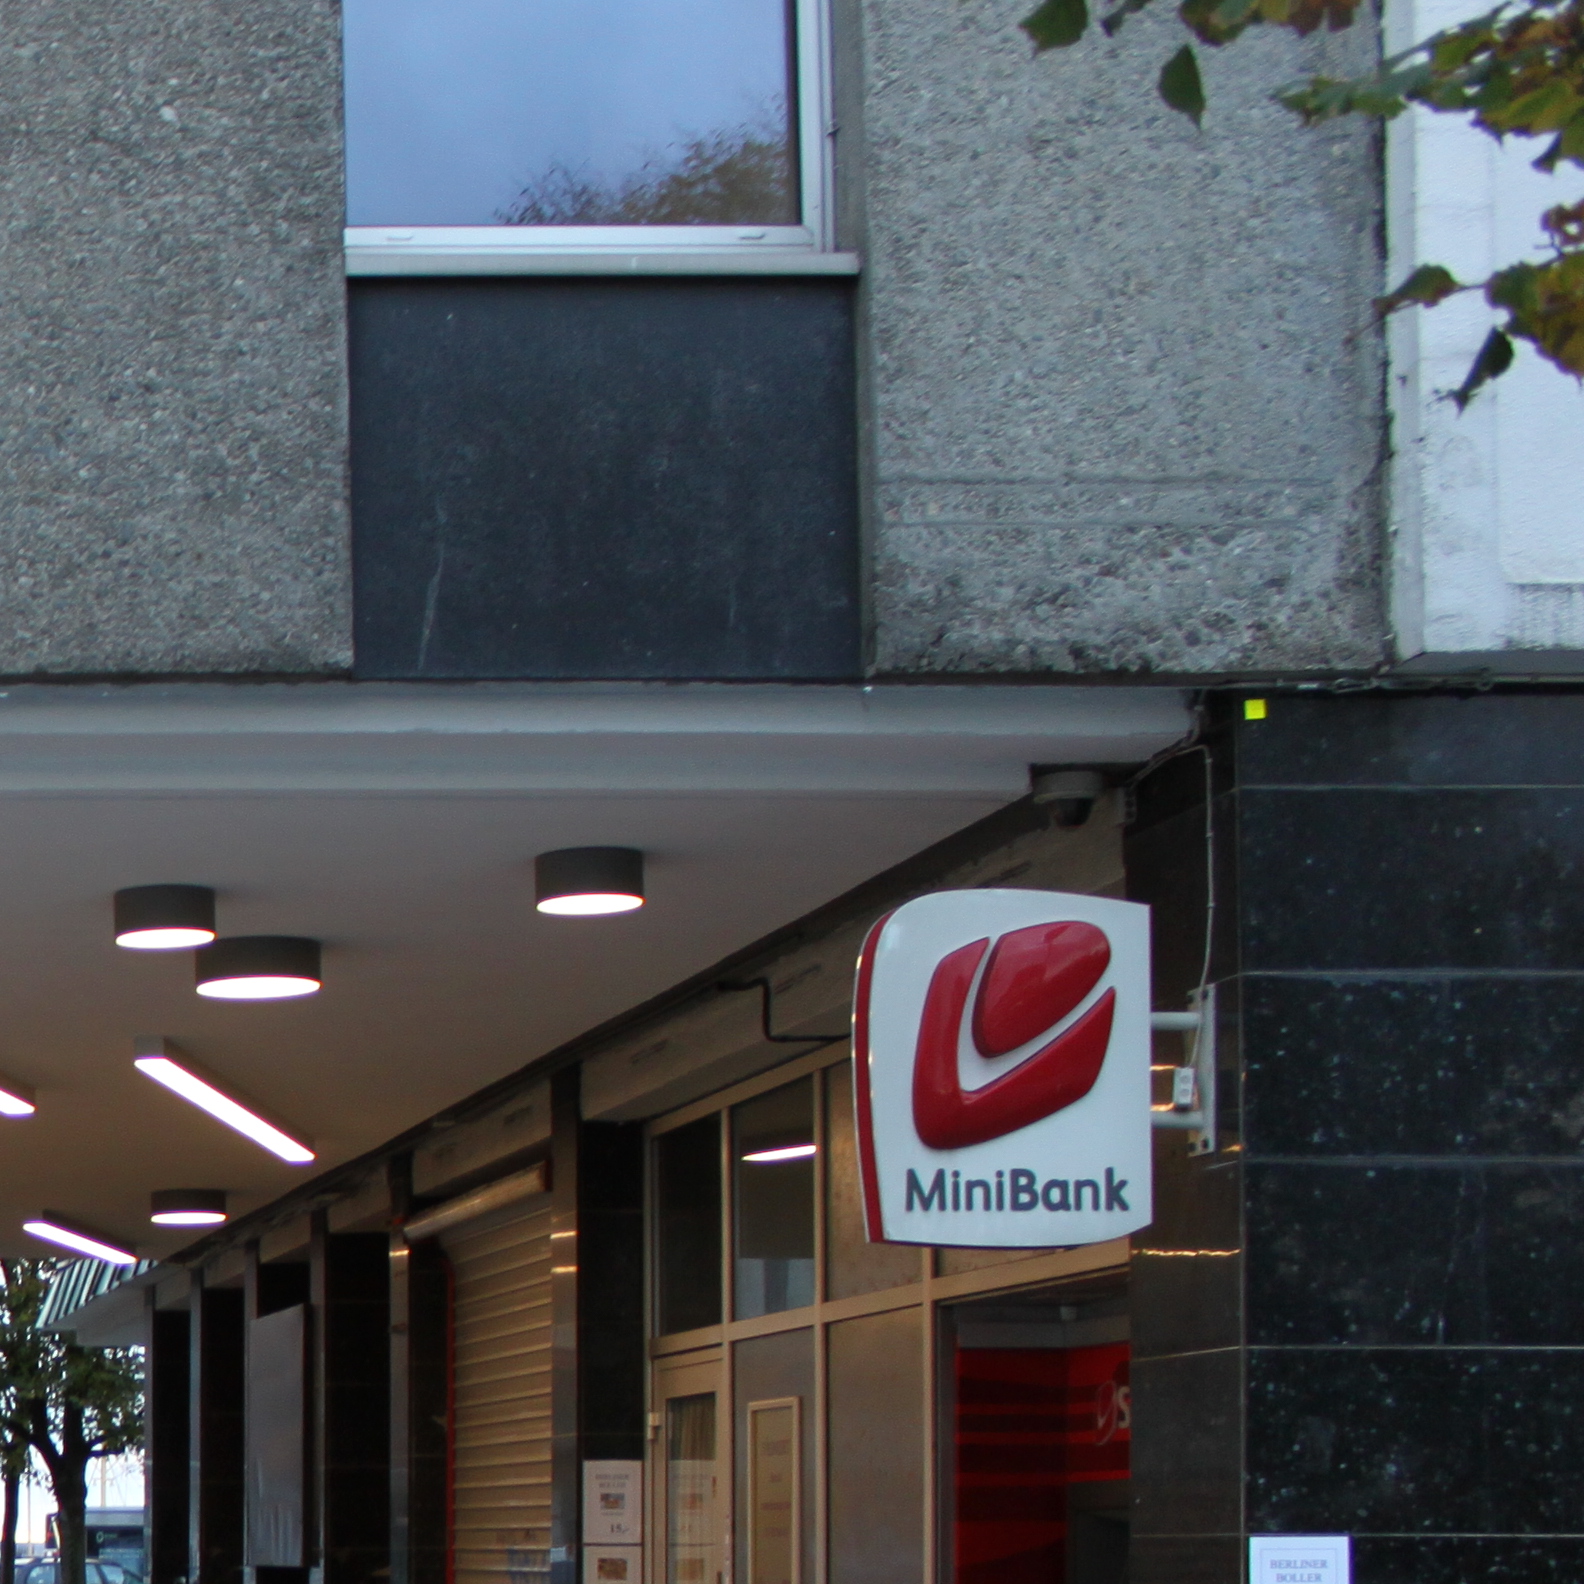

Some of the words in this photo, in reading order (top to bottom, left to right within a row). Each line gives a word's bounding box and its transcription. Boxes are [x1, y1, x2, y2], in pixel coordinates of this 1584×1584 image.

[905, 1166, 1130, 1213] MiniBank
[1270, 1559, 1328, 1569] BERLINER
[1276, 1573, 1322, 1583] BOLLER
